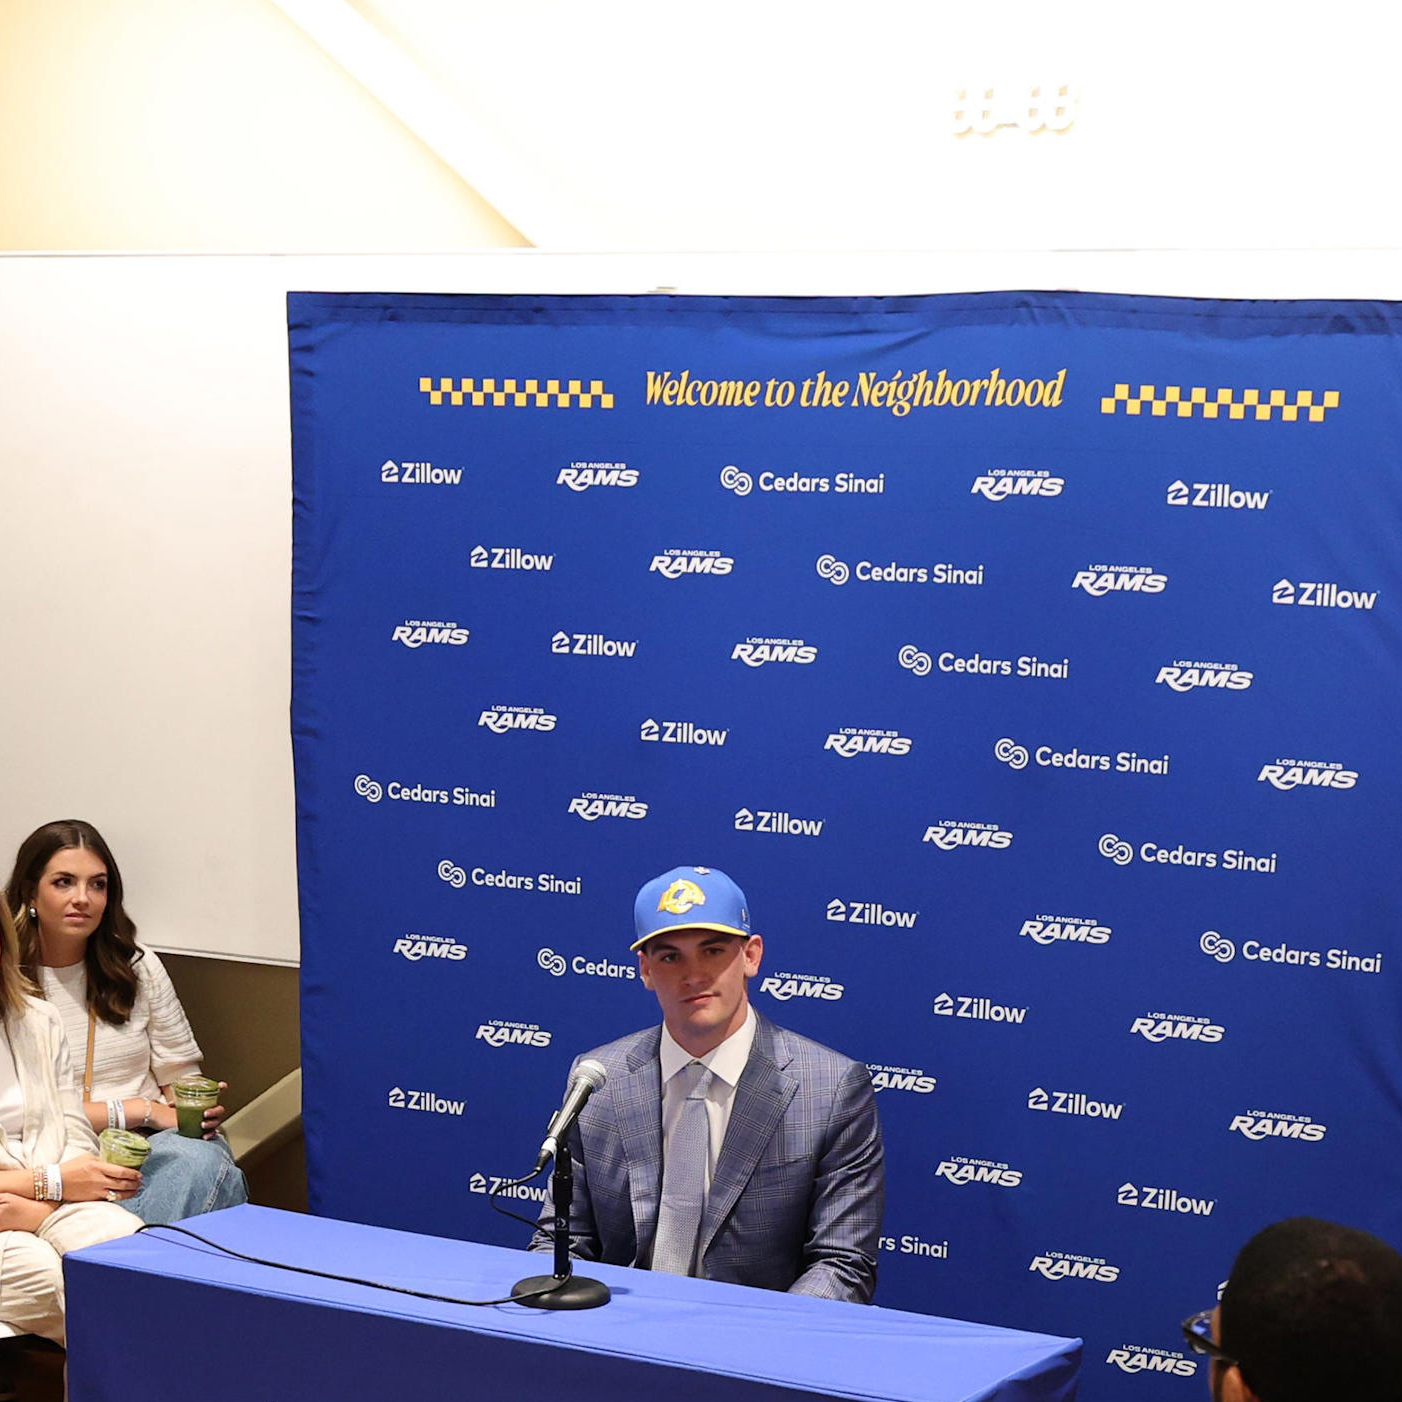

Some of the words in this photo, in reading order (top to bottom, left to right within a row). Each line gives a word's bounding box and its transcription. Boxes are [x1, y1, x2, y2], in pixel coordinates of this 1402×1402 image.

[646, 369, 760, 407] Welcome
[764, 378, 796, 407] to
[800, 370, 850, 408] the
[851, 367, 1067, 417] Neighborhood
[401, 462, 463, 485] Zillow
[557, 469, 639, 491] RAMS
[758, 471, 830, 493] Cedars
[834, 472, 885, 494] Sinai
[971, 477, 1064, 501] RAMS
[1191, 482, 1270, 510] Zillow
[490, 547, 554, 571] Zillow
[649, 556, 734, 578] RAMS
[1109, 566, 1152, 574] ANGELES
[855, 560, 928, 583] Cedars
[932, 563, 984, 585] Sinai
[1072, 571, 1167, 596] RAMS
[1297, 582, 1377, 610] Zillow
[392, 626, 469, 648] RAMS
[572, 633, 637, 658] Zillow
[731, 644, 817, 667] RAMS
[938, 651, 1012, 676] Cedars
[1016, 655, 1069, 679] Sinai
[1193, 662, 1238, 671] ANGELES
[1155, 667, 1253, 692] RAMS
[478, 711, 557, 733] RAMS
[661, 721, 727, 746] Zillow
[858, 729, 898, 737] ANGELES
[824, 734, 912, 757] RAMS
[1035, 745, 1111, 771] Cedars
[1115, 751, 1170, 775] Sinai
[1296, 761, 1342, 770] ANGELES
[1258, 765, 1358, 790] RAMS
[387, 781, 449, 804] Cedars
[452, 786, 496, 808] Sinai
[598, 794, 635, 802] ANGELES
[568, 799, 648, 820] RAMS
[756, 811, 823, 836] Zillow
[957, 822, 998, 831] ANGELES
[923, 827, 1013, 850] RAMS
[1139, 842, 1217, 868] Cedars
[1221, 849, 1277, 873] Sinai
[471, 867, 534, 891] Cedars
[537, 873, 582, 895] Sinai
[848, 902, 917, 928] Zillow
[1055, 917, 1097, 926] ANGELES
[421, 936, 455, 944] ANGELES
[1020, 921, 1111, 944] RAMS
[393, 939, 467, 960] RAMS
[1242, 940, 1321, 967] Cedars
[1325, 948, 1382, 973] Sinai
[571, 956, 636, 980] Cedars
[792, 974, 830, 983] ANGELES
[760, 978, 844, 1000] RAMS
[956, 996, 1027, 1024] Zillow
[1167, 1015, 1210, 1024] ANGELES
[476, 1025, 551, 1047] RAMS
[504, 1022, 539, 1030] ANGELES
[1130, 1018, 1225, 1042] RAMS
[869, 1071, 936, 1092] AMS
[883, 1066, 922, 1075] ANGELES
[407, 1090, 465, 1116] Zillow
[1051, 1091, 1123, 1120] Zillow
[1229, 1116, 1326, 1141] RAMS
[1267, 1113, 1311, 1123] ANGELES
[935, 1162, 1022, 1186] RAMS
[969, 1159, 1008, 1169] ANGELES
[1140, 1186, 1215, 1216] Zillow
[900, 1235, 948, 1259] Sinai
[1029, 1257, 1119, 1282] RAMS
[1064, 1254, 1105, 1264] ANGELES
[1106, 1350, 1197, 1376] RAMS
[1142, 1348, 1183, 1358] ANGELES
